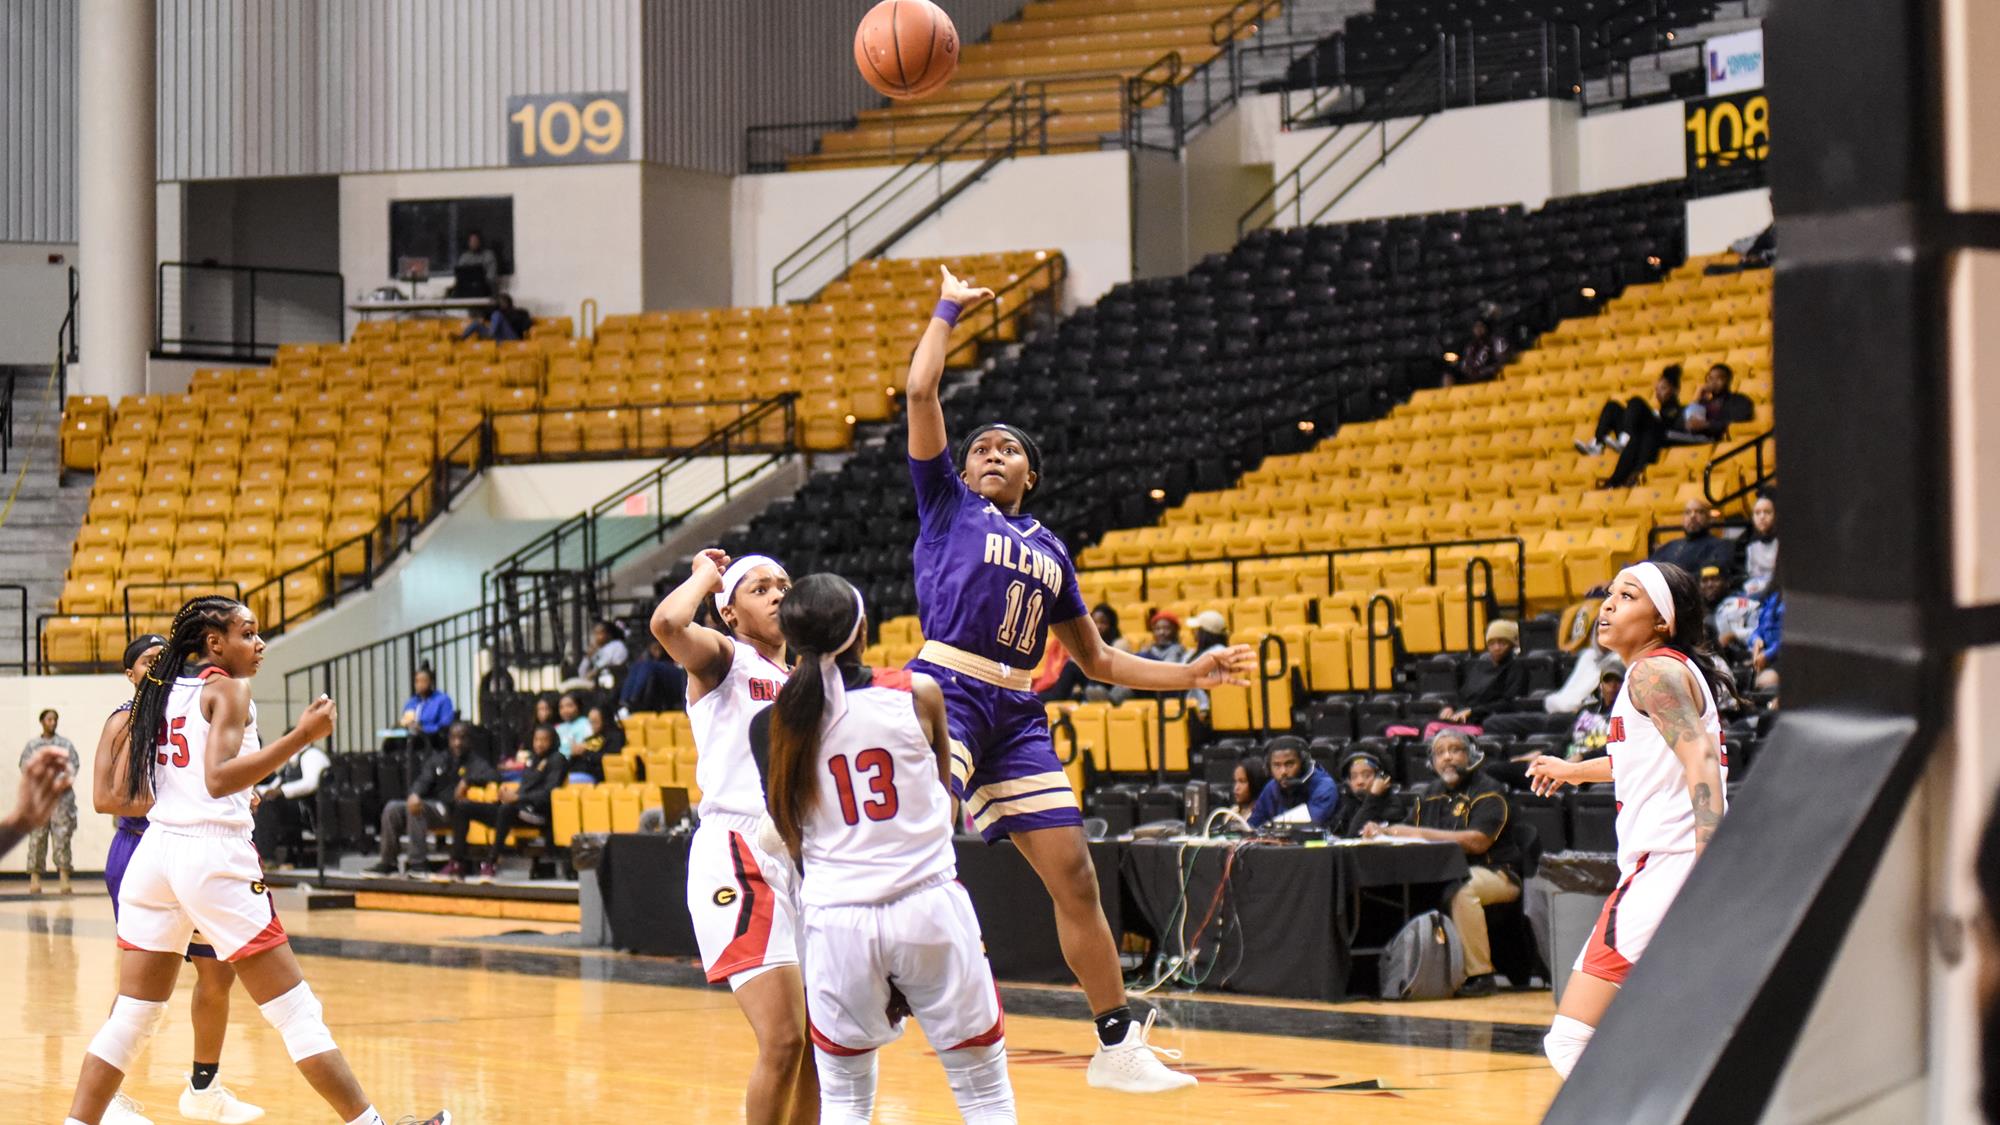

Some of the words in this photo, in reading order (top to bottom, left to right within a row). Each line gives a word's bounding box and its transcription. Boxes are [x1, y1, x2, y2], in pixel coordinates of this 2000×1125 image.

[511, 99, 625, 157] 109
[1687, 96, 1769, 169] 108
[997, 580, 1043, 655] 11
[828, 748, 898, 826] 13
